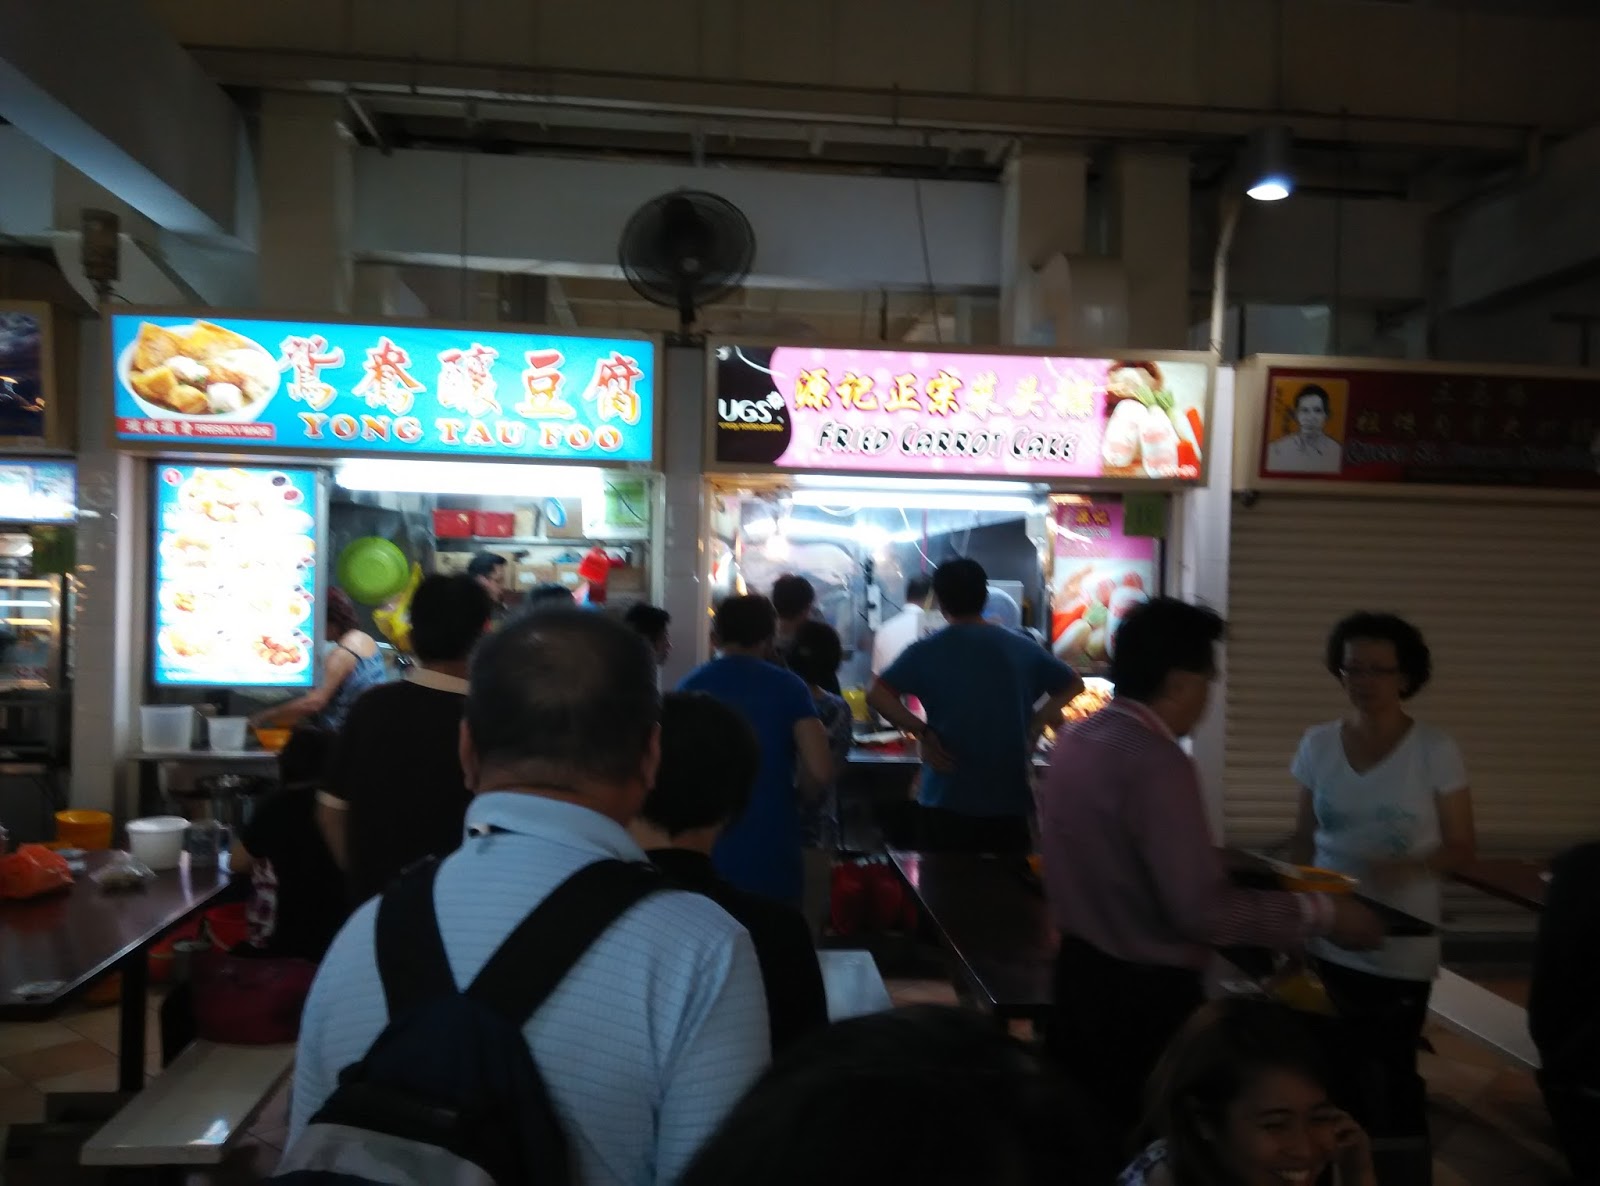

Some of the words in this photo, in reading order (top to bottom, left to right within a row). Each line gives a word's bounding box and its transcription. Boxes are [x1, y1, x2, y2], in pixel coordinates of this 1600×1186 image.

[298, 411, 425, 444] YONG
[435, 417, 519, 449] TAU
[540, 423, 624, 452] FOO
[717, 398, 773, 424] UGS
[816, 420, 893, 456] FRIED
[899, 421, 1006, 458] CARROT
[1008, 426, 1079, 461] CAKE
